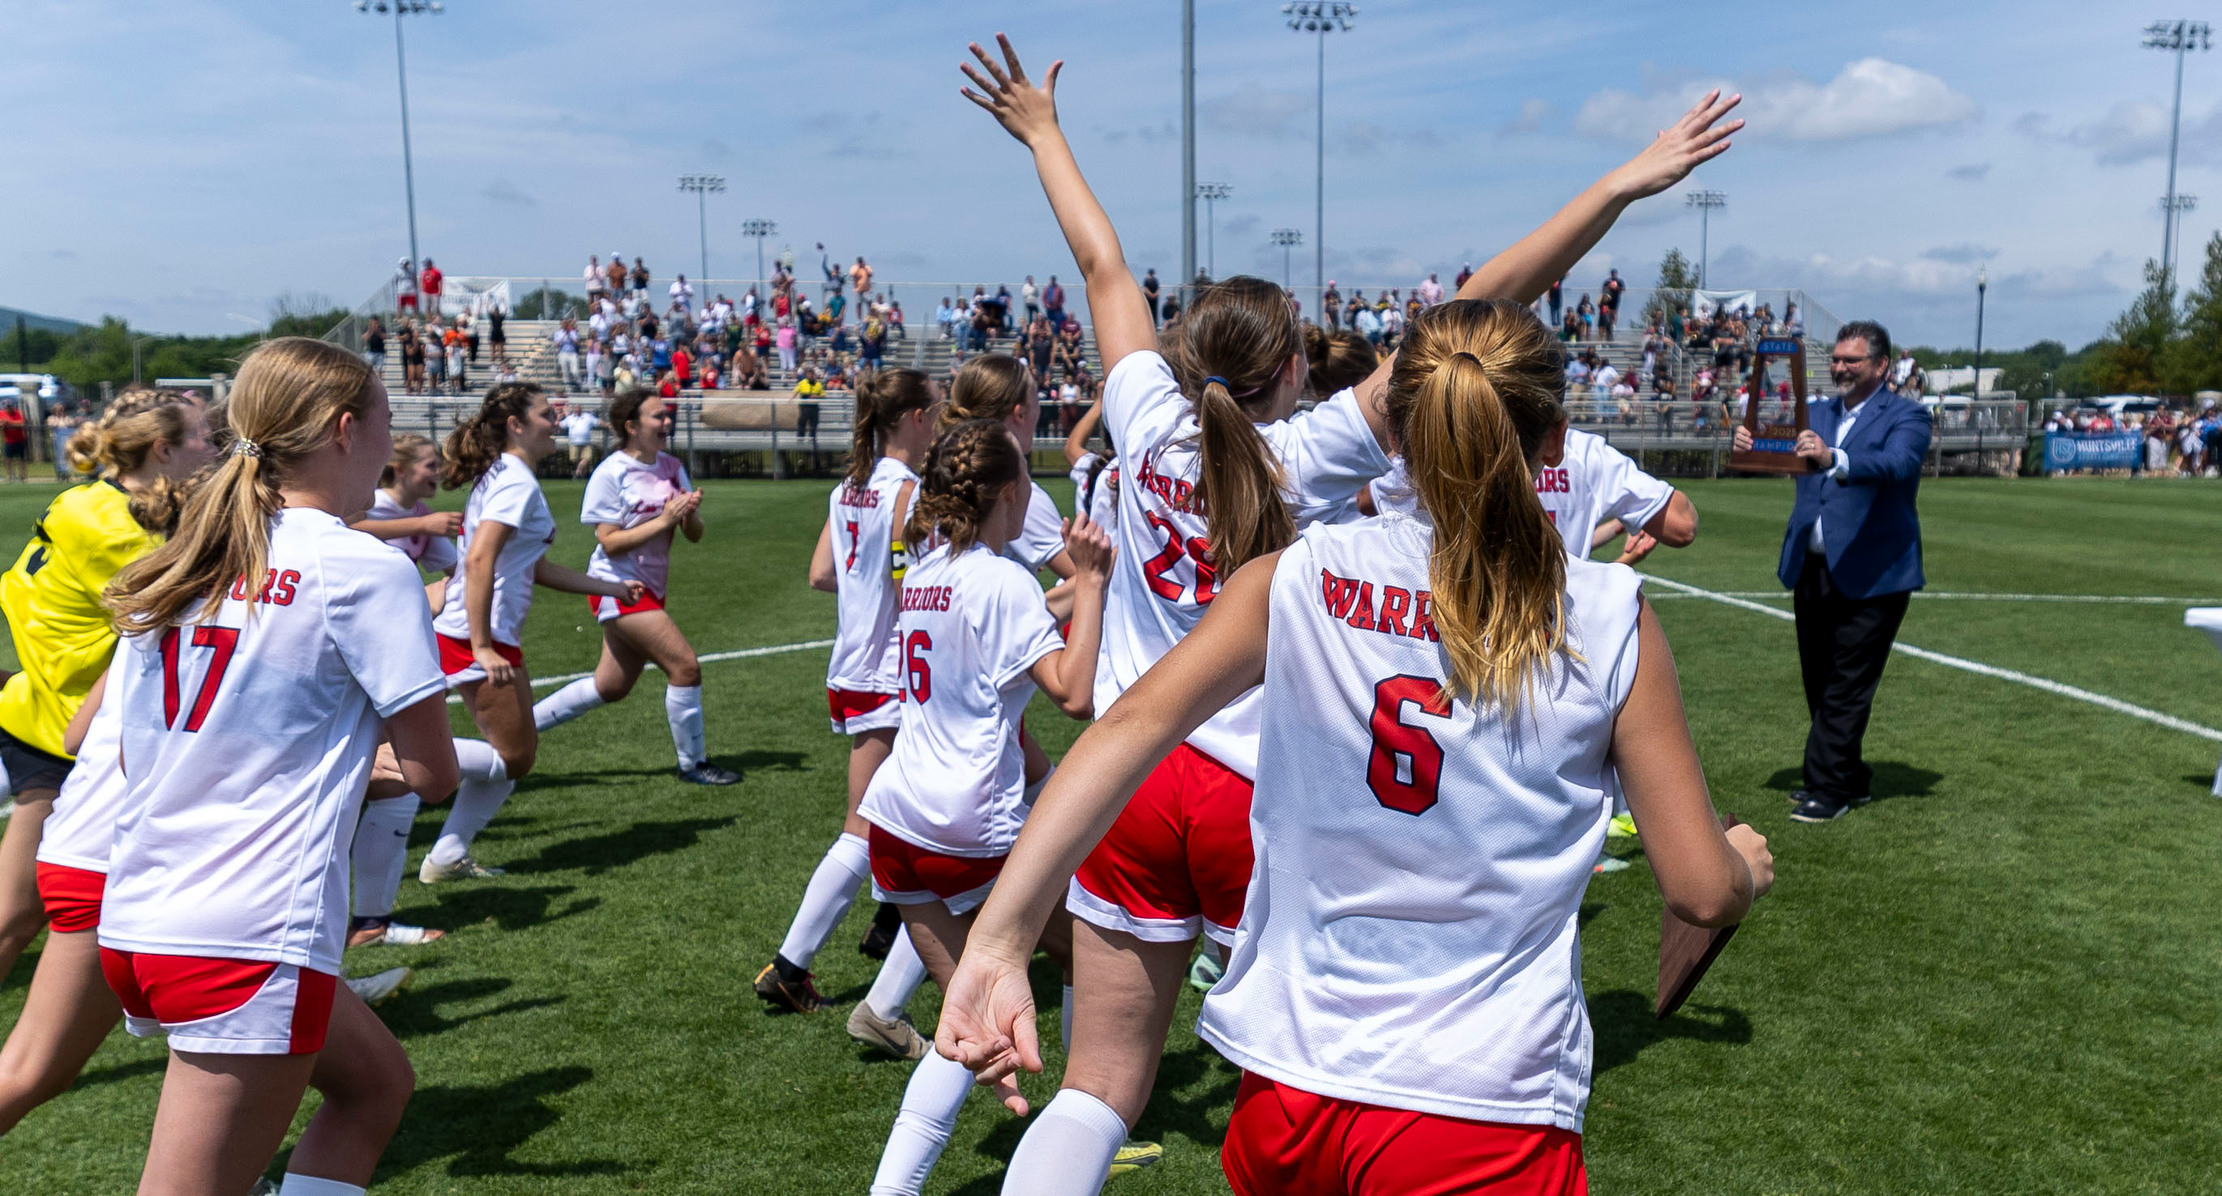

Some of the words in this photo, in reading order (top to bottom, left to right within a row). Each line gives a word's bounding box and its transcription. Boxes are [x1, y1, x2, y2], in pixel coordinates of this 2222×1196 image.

[1764, 342, 1794, 351] STATE
[2077, 438, 2138, 453] HUNTSVILLE
[891, 549, 906, 571] C
[158, 625, 241, 733] 17
[1366, 673, 1454, 818] 6
